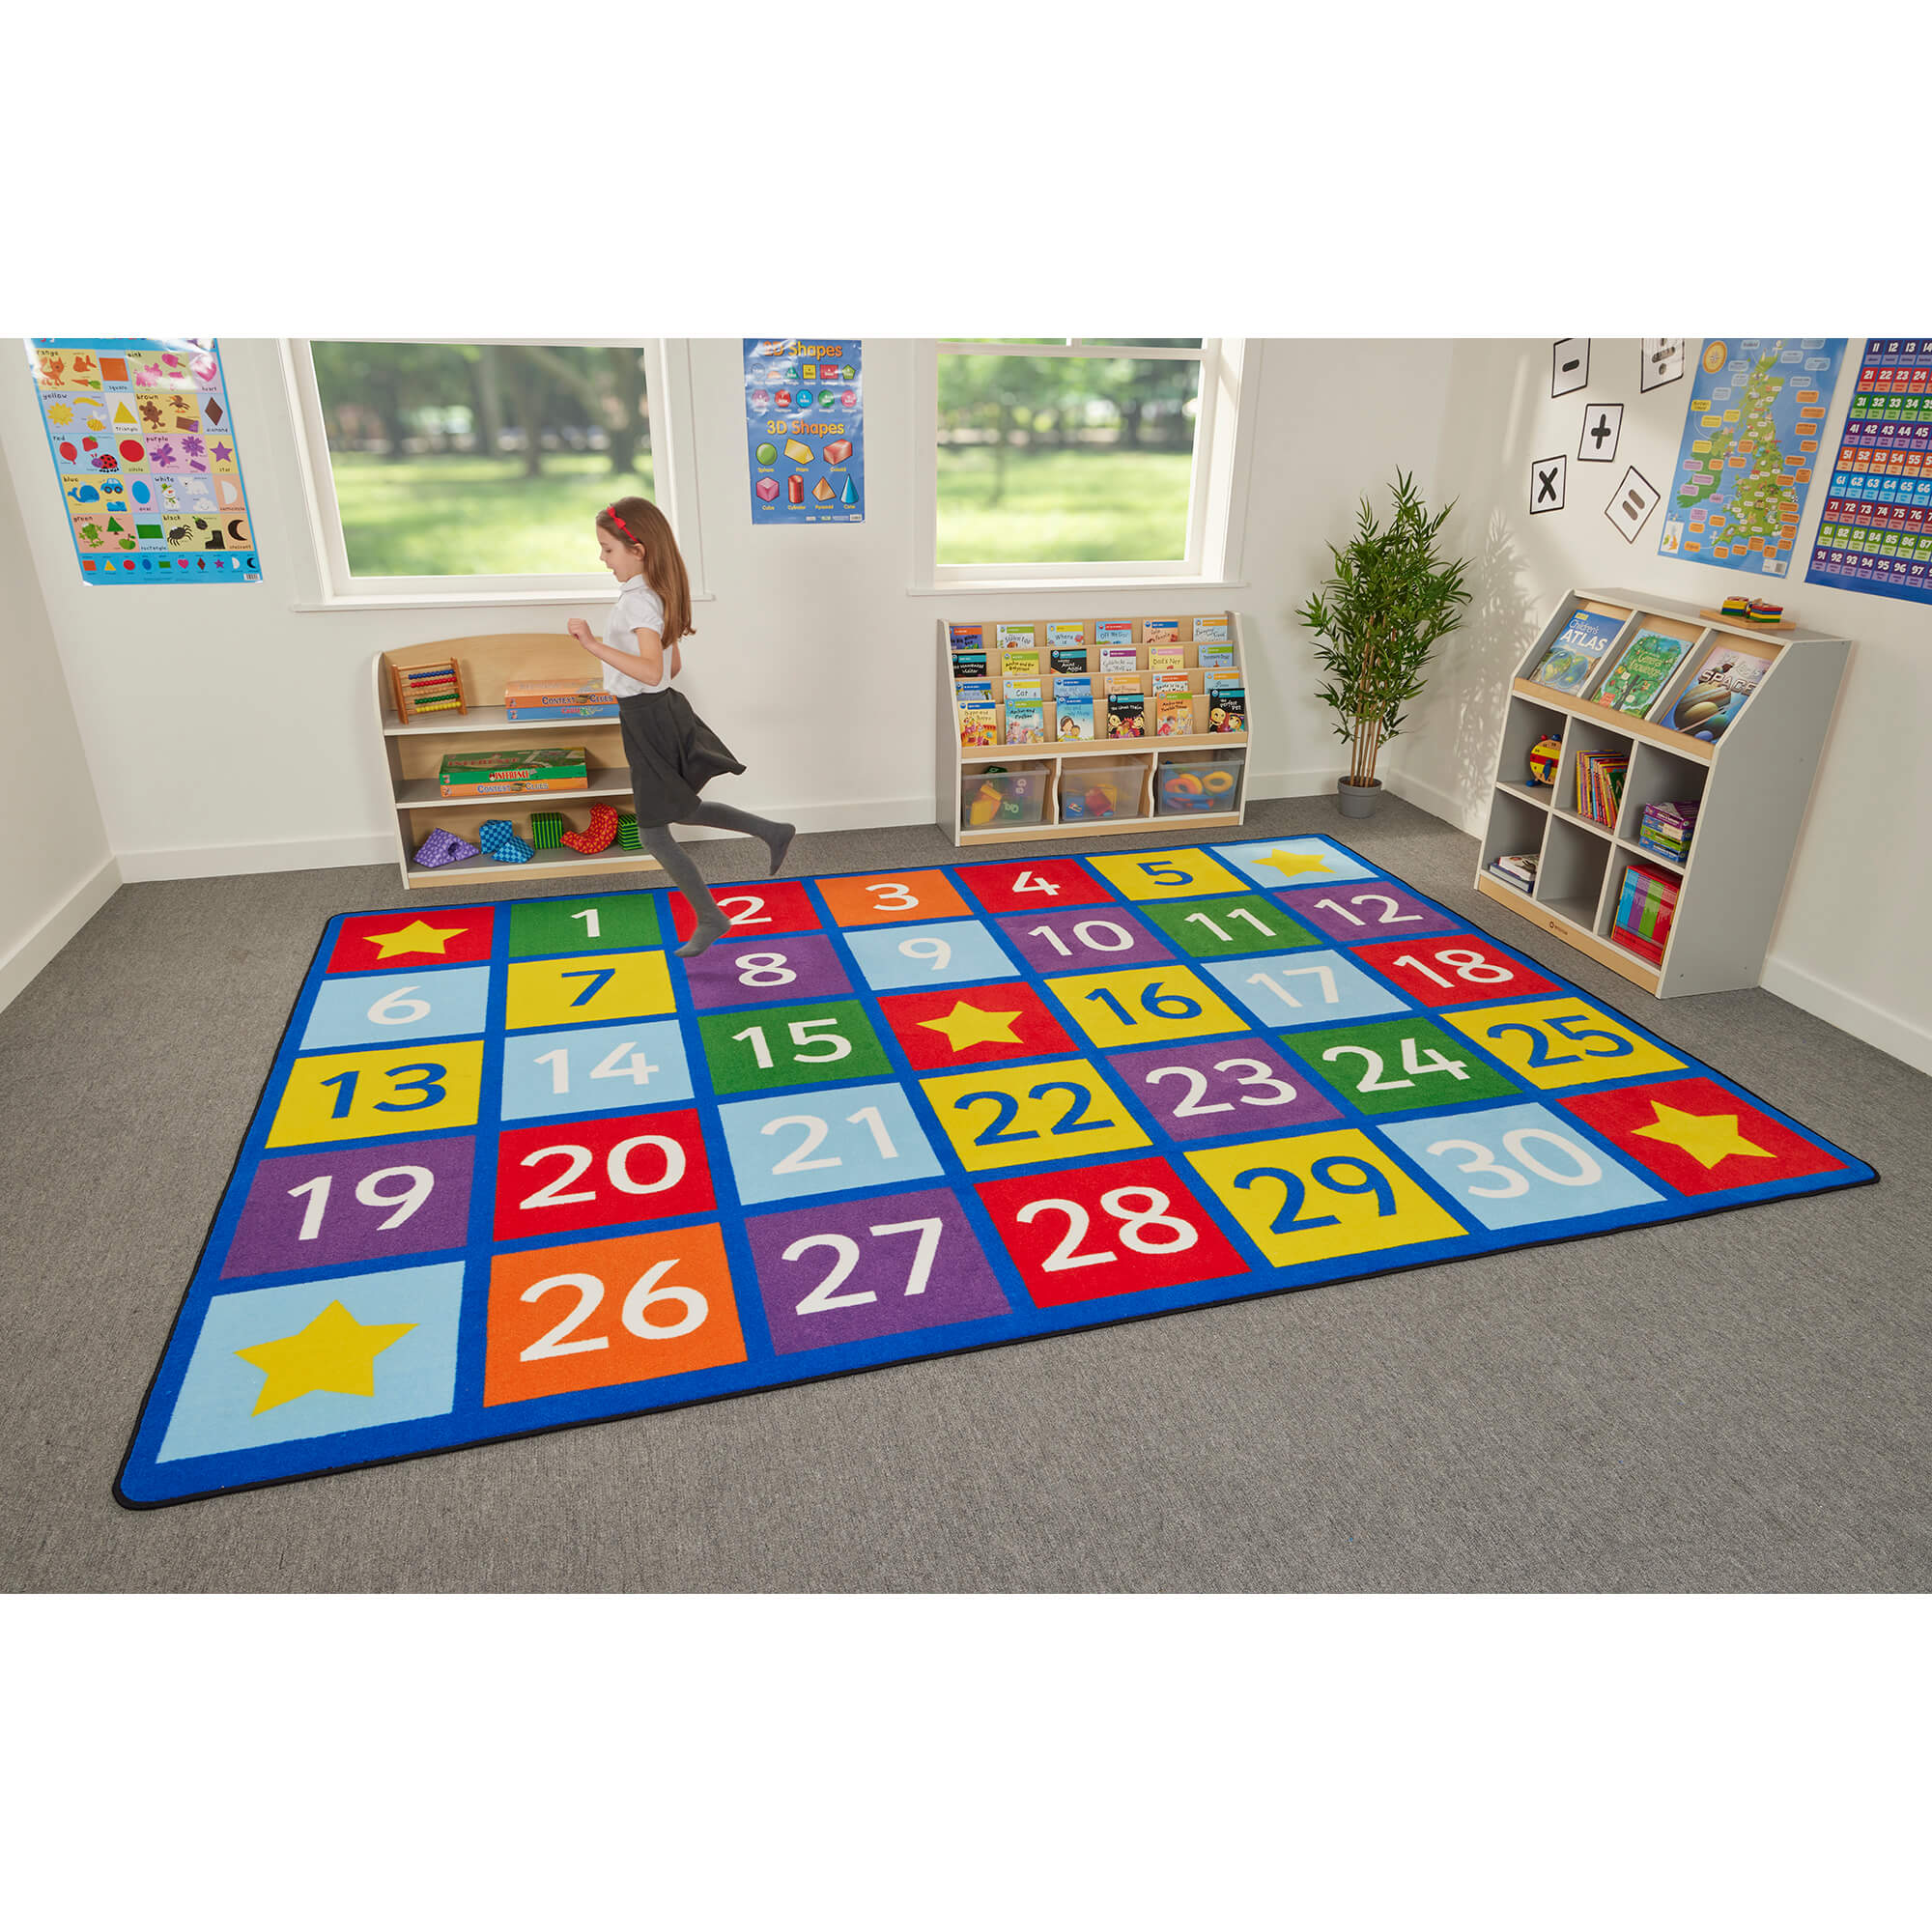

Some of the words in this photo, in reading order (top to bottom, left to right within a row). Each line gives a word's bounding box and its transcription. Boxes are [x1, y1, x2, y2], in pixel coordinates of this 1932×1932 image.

[788, 342, 842, 360] Shapes
[1872, 343, 1880, 352] 11
[1888, 342, 1898, 353] 12
[1905, 342, 1916, 353] 13
[1863, 370, 1874, 380] 21
[1879, 370, 1892, 380] 22
[1896, 370, 1909, 381] 23
[1913, 370, 1927, 381] 24
[1856, 397, 1867, 407] 31
[1871, 397, 1885, 407] 32
[1889, 398, 1901, 408] 33
[1905, 398, 1918, 409] 34
[767, 421, 787, 435] 3D
[791, 420, 844, 438] Shapes
[1849, 424, 1860, 433] 41
[1864, 425, 1878, 434] 42
[1882, 425, 1894, 435] 43
[1898, 426, 1912, 436] 44
[1916, 427, 1929, 438] 45
[1842, 449, 1853, 459] 51
[1858, 451, 1870, 461] 52
[1875, 452, 1887, 462] 53
[1890, 453, 1904, 463] 54
[1909, 455, 1921, 464] 55
[1836, 475, 1846, 485] 61
[1851, 477, 1863, 486] 62
[1867, 478, 1880, 488] 63
[1884, 480, 1897, 490] 64
[1900, 481, 1913, 492] 65
[1918, 483, 1930, 493] 66
[1830, 501, 1839, 511] 71
[1844, 502, 1856, 512] 72
[1860, 504, 1872, 514] 73
[1877, 506, 1888, 516] 74
[1893, 508, 1905, 518] 75
[1910, 510, 1922, 520] 76
[1823, 526, 1833, 535] 81
[1837, 527, 1849, 537] 82
[1853, 530, 1865, 540] 83
[1868, 532, 1882, 542] 84
[1886, 534, 1898, 544] 85
[1901, 536, 1915, 547] 86
[1919, 539, 1932, 549] 87
[1817, 551, 1826, 559] 91
[1831, 553, 1843, 562] 92
[1846, 554, 1859, 565] 93
[1861, 557, 1873, 567] 94
[1877, 560, 1889, 570] 95
[1894, 562, 1907, 573] 96
[1911, 565, 1924, 576] 97
[1559, 629, 1608, 651] ATLAS
[1569, 619, 1600, 634] Children's
[541, 696, 576, 705] CONTEXT
[589, 694, 613, 703] CLUES
[1698, 669, 1758, 696] SPACE
[477, 784, 511, 793] CONTEXT
[525, 781, 549, 790] CLUES
[495, 770, 529, 781] INFERENCE
[1011, 870, 1061, 895] 4
[1136, 860, 1193, 887] 5
[716, 895, 772, 926] 2
[865, 883, 920, 911] 3
[1313, 894, 1424, 926] 12
[570, 908, 601, 938] 1
[1028, 920, 1134, 956] 10
[1183, 907, 1276, 942] 11
[734, 952, 797, 987] 8
[897, 937, 952, 971] 9
[1393, 949, 1514, 988] 18
[560, 968, 615, 1008] 7
[1084, 981, 1203, 1026] 16
[1246, 965, 1339, 1009] 17
[366, 985, 432, 1026] 6
[731, 1017, 852, 1069] 15
[1487, 1014, 1634, 1068] 25
[533, 1041, 660, 1094] 14
[1321, 1037, 1470, 1094] 24
[320, 1063, 447, 1120] 13
[1145, 1058, 1297, 1119] 23
[953, 1081, 1116, 1147] 22
[759, 1106, 898, 1176] 21
[519, 1134, 687, 1211] 20
[1426, 1127, 1603, 1199] 30
[287, 1165, 435, 1241] 19
[1233, 1155, 1397, 1236] 29
[1016, 1185, 1199, 1272] 28
[781, 1217, 943, 1317] 27
[519, 1258, 708, 1364] 26
